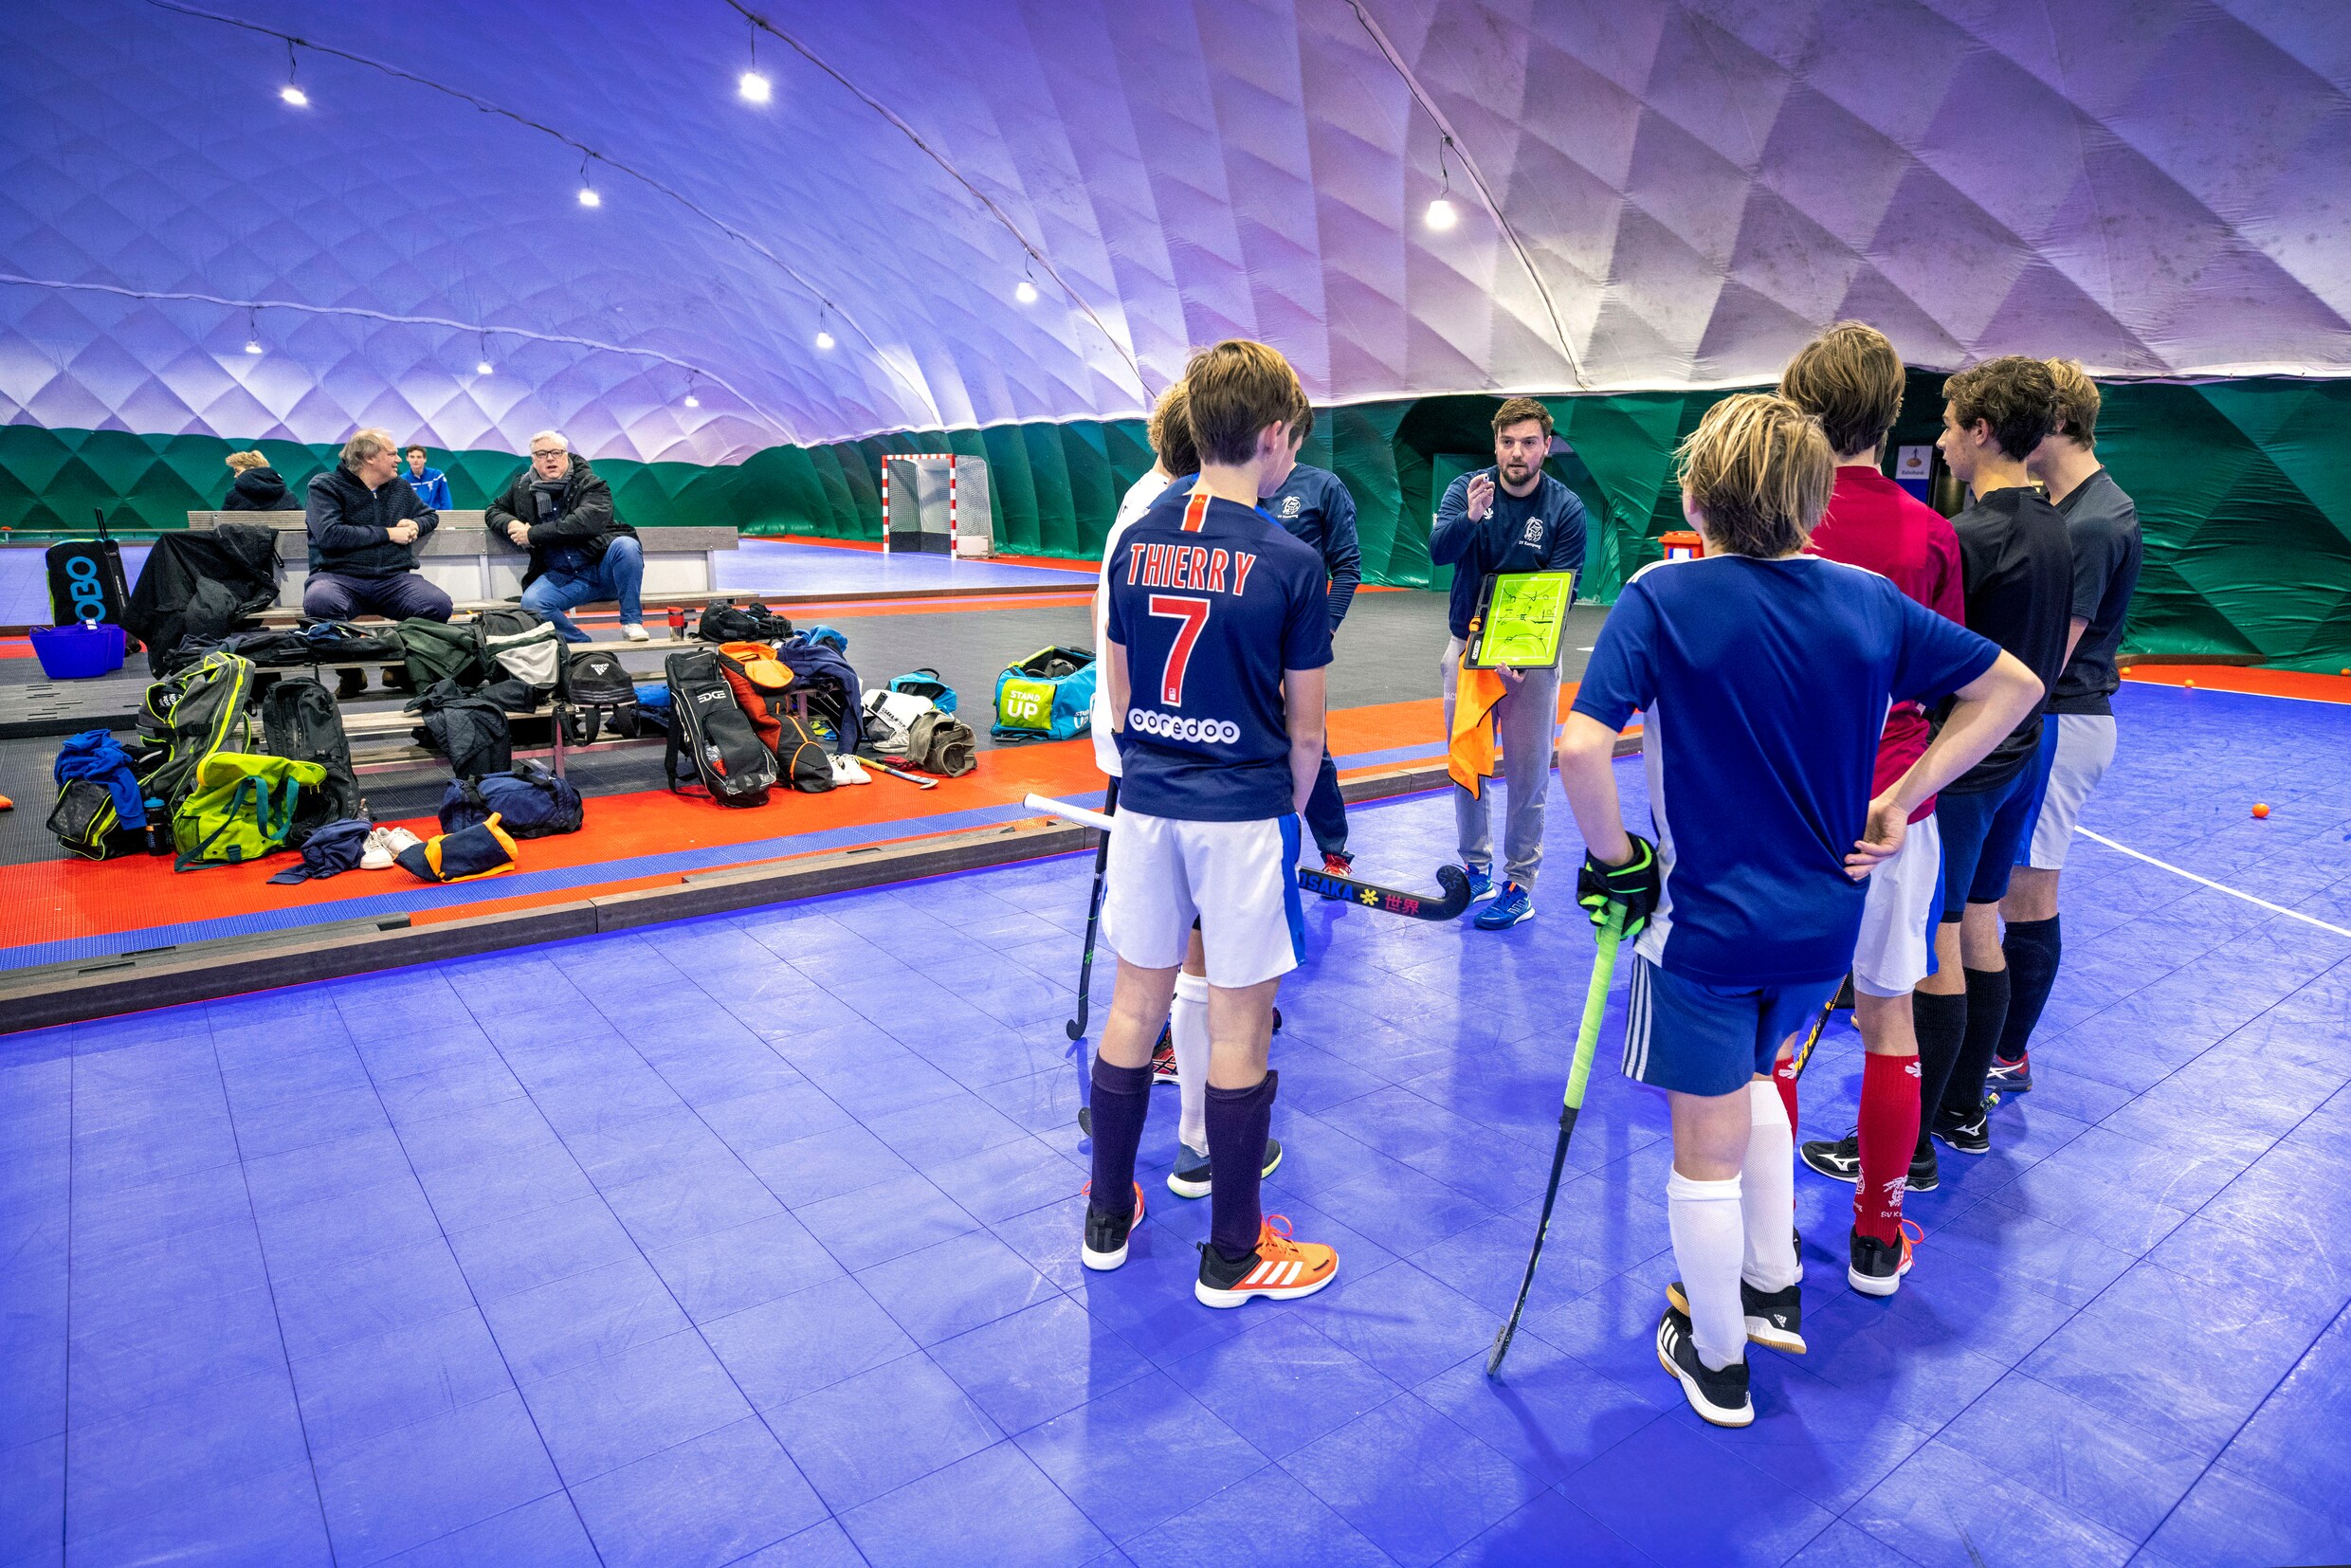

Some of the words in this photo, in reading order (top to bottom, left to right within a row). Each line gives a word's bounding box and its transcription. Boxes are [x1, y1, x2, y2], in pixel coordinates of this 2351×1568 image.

[1127, 543, 1257, 596] THIERRY
[65, 556, 106, 622] OBO
[1149, 593, 1212, 707] 7
[697, 690, 727, 704] EDGE
[1011, 690, 1041, 702] STAND
[1007, 700, 1039, 720] UP
[1129, 709, 1239, 742] ooredoo
[1385, 893, 1419, 915] 世界
